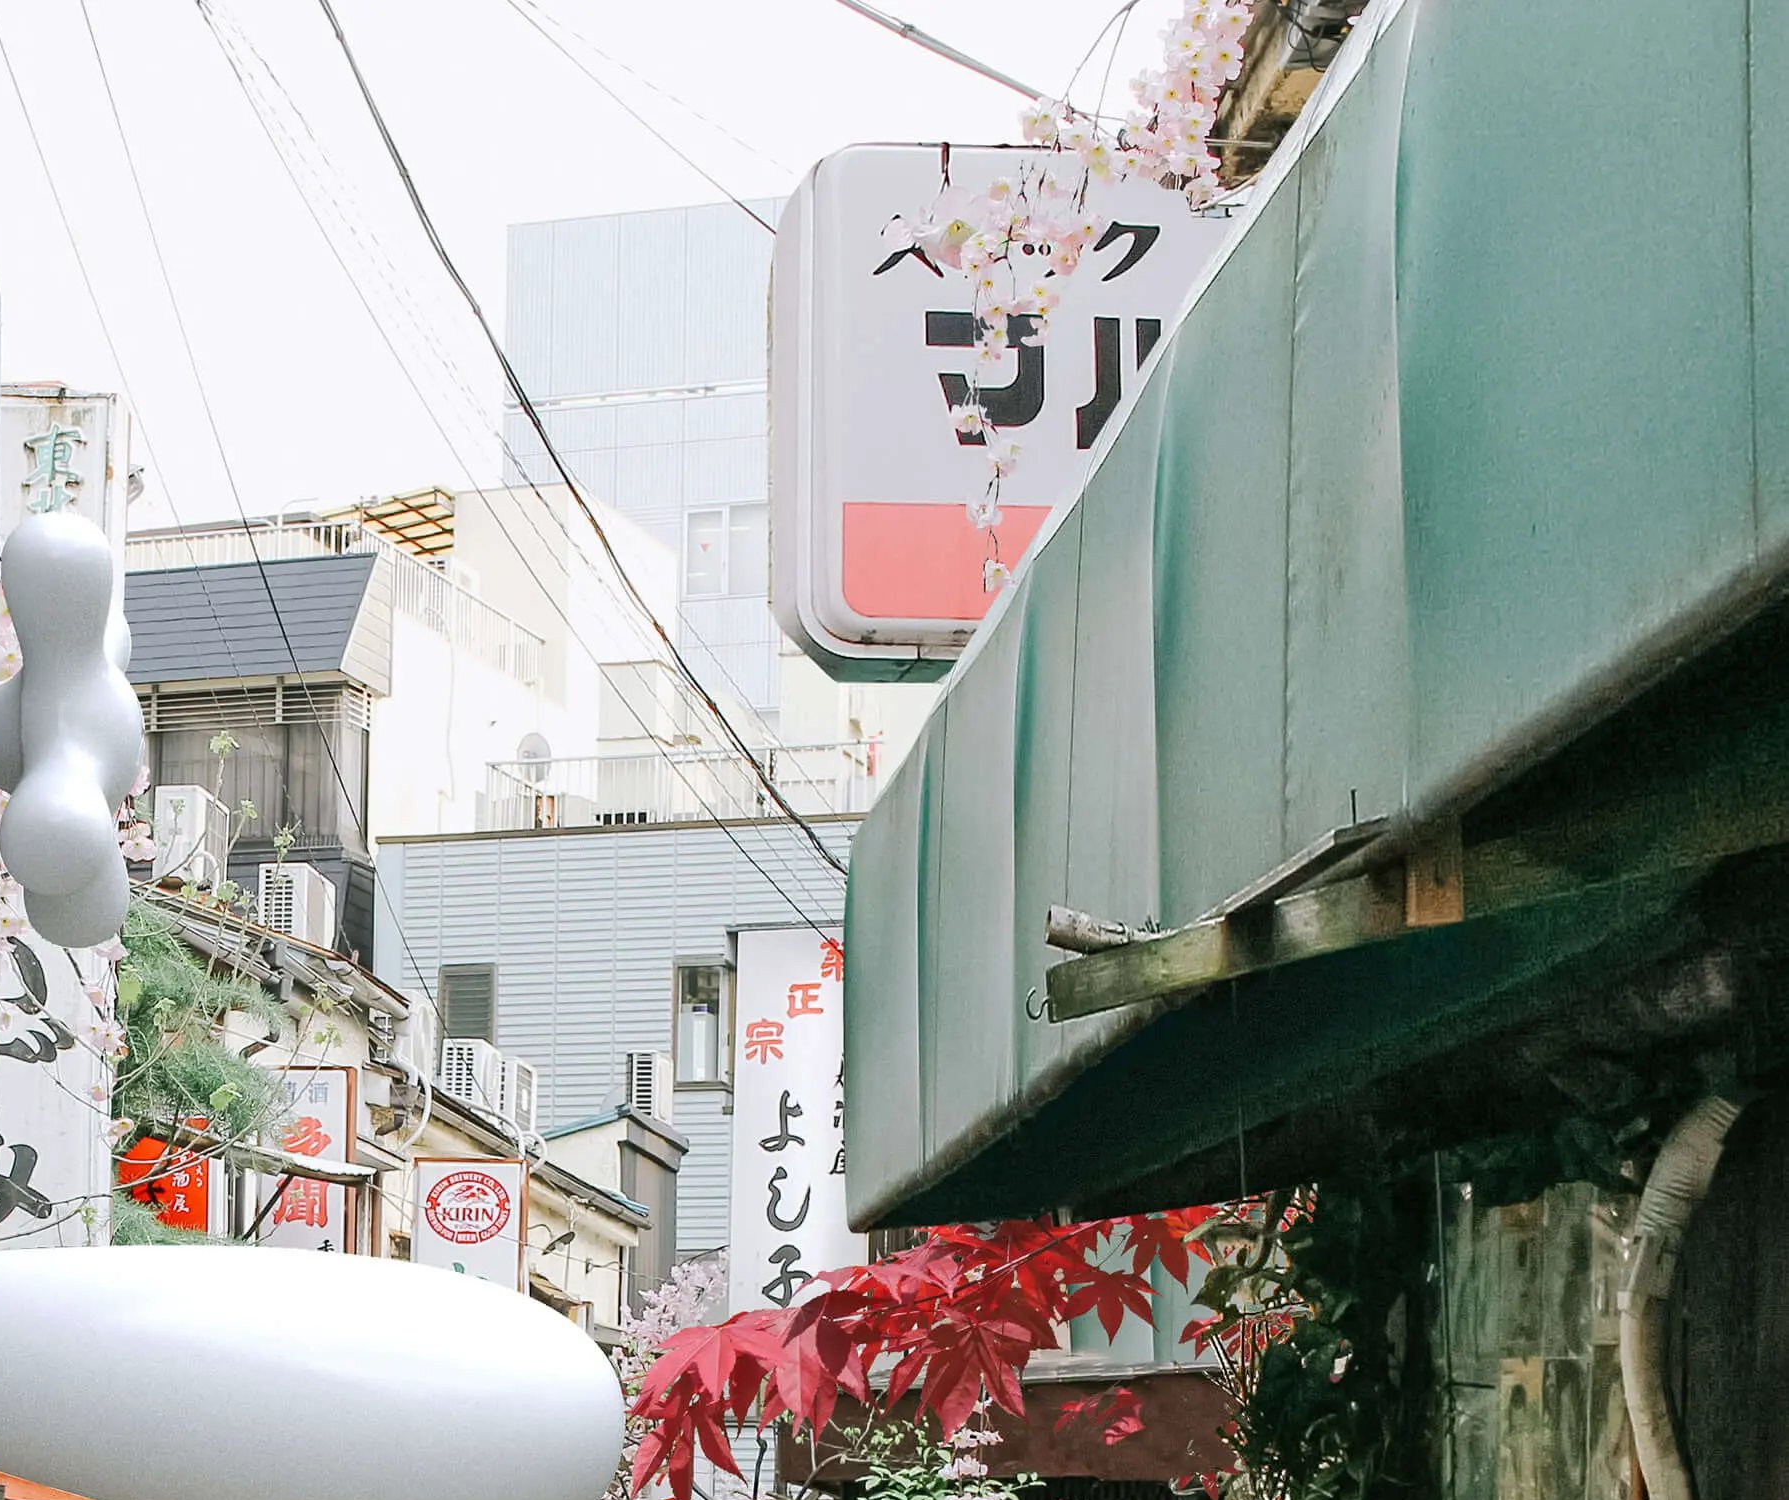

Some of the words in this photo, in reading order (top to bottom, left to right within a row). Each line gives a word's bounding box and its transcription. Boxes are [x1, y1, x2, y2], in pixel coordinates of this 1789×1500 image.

[442, 1207, 494, 1222] KIRIN
[758, 1089, 813, 1308] よし子
